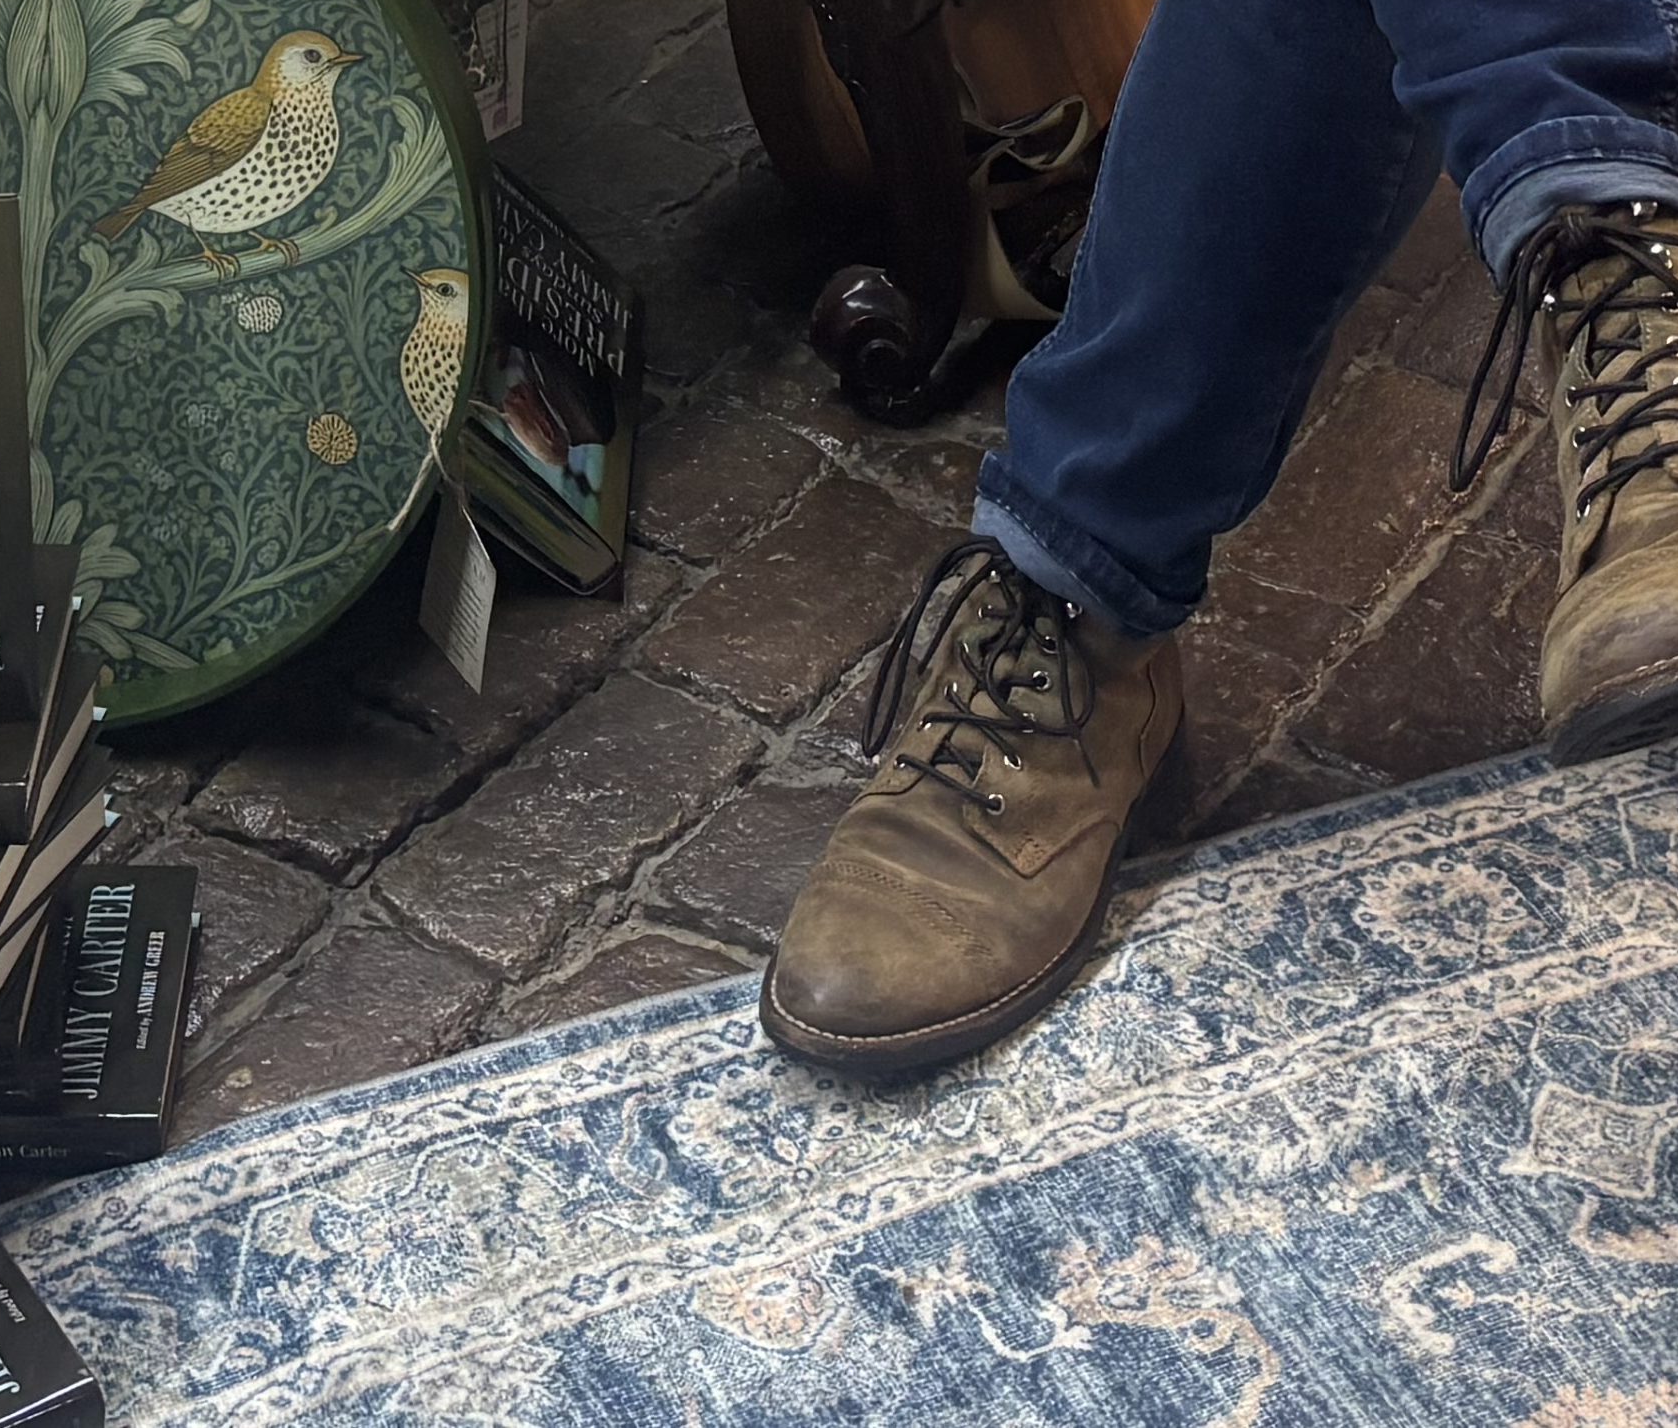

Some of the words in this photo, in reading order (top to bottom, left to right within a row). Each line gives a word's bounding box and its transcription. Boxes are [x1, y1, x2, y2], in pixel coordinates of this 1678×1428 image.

[498, 242, 625, 377] PRESID
[73, 883, 136, 996] CARTER
[145, 931, 165, 967] GREER
[137, 969, 159, 1015] ANDREW
[62, 1007, 112, 1100] JIMMY
[136, 1026, 151, 1050] Edited
[20, 1142, 70, 1158] Carter
